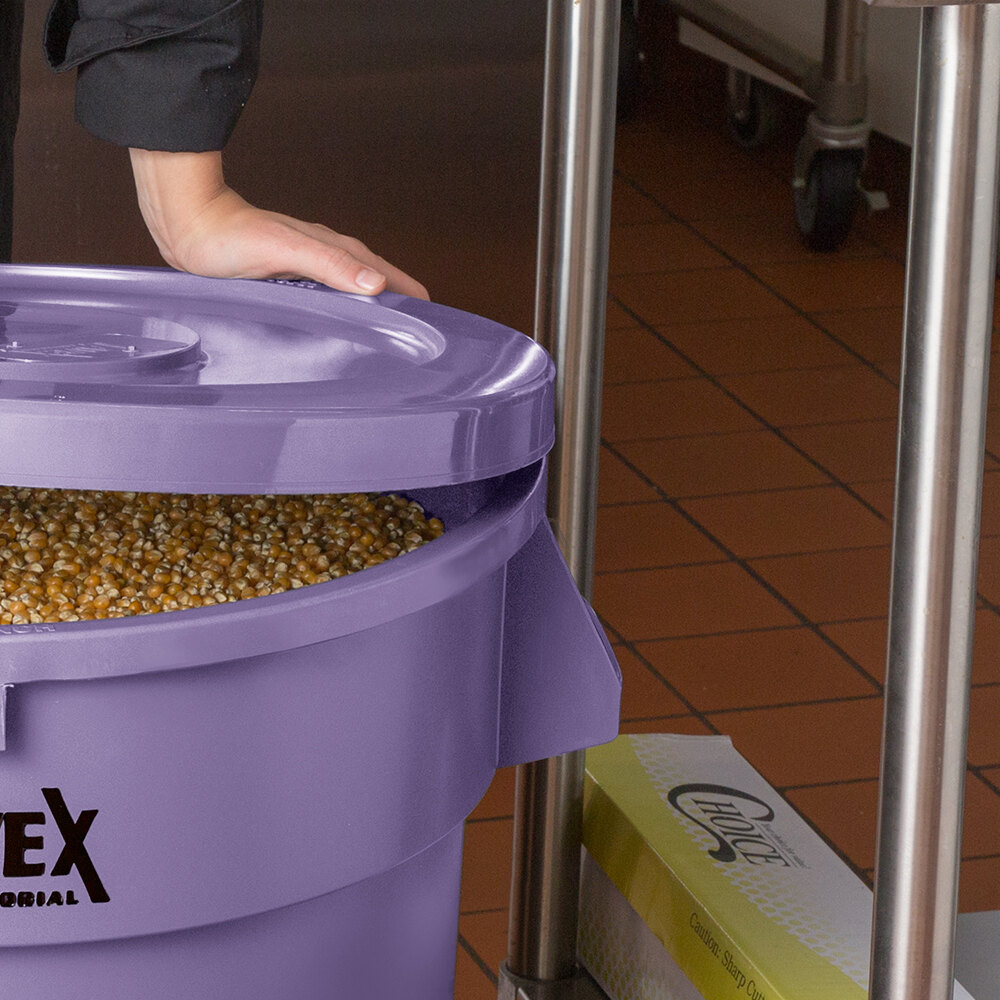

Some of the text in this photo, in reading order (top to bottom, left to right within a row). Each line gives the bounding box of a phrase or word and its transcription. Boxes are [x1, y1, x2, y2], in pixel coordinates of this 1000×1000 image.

[668, 783, 791, 868] CHOICE
[689, 912, 721, 958] Caution:
[721, 950, 747, 989] Sharp
